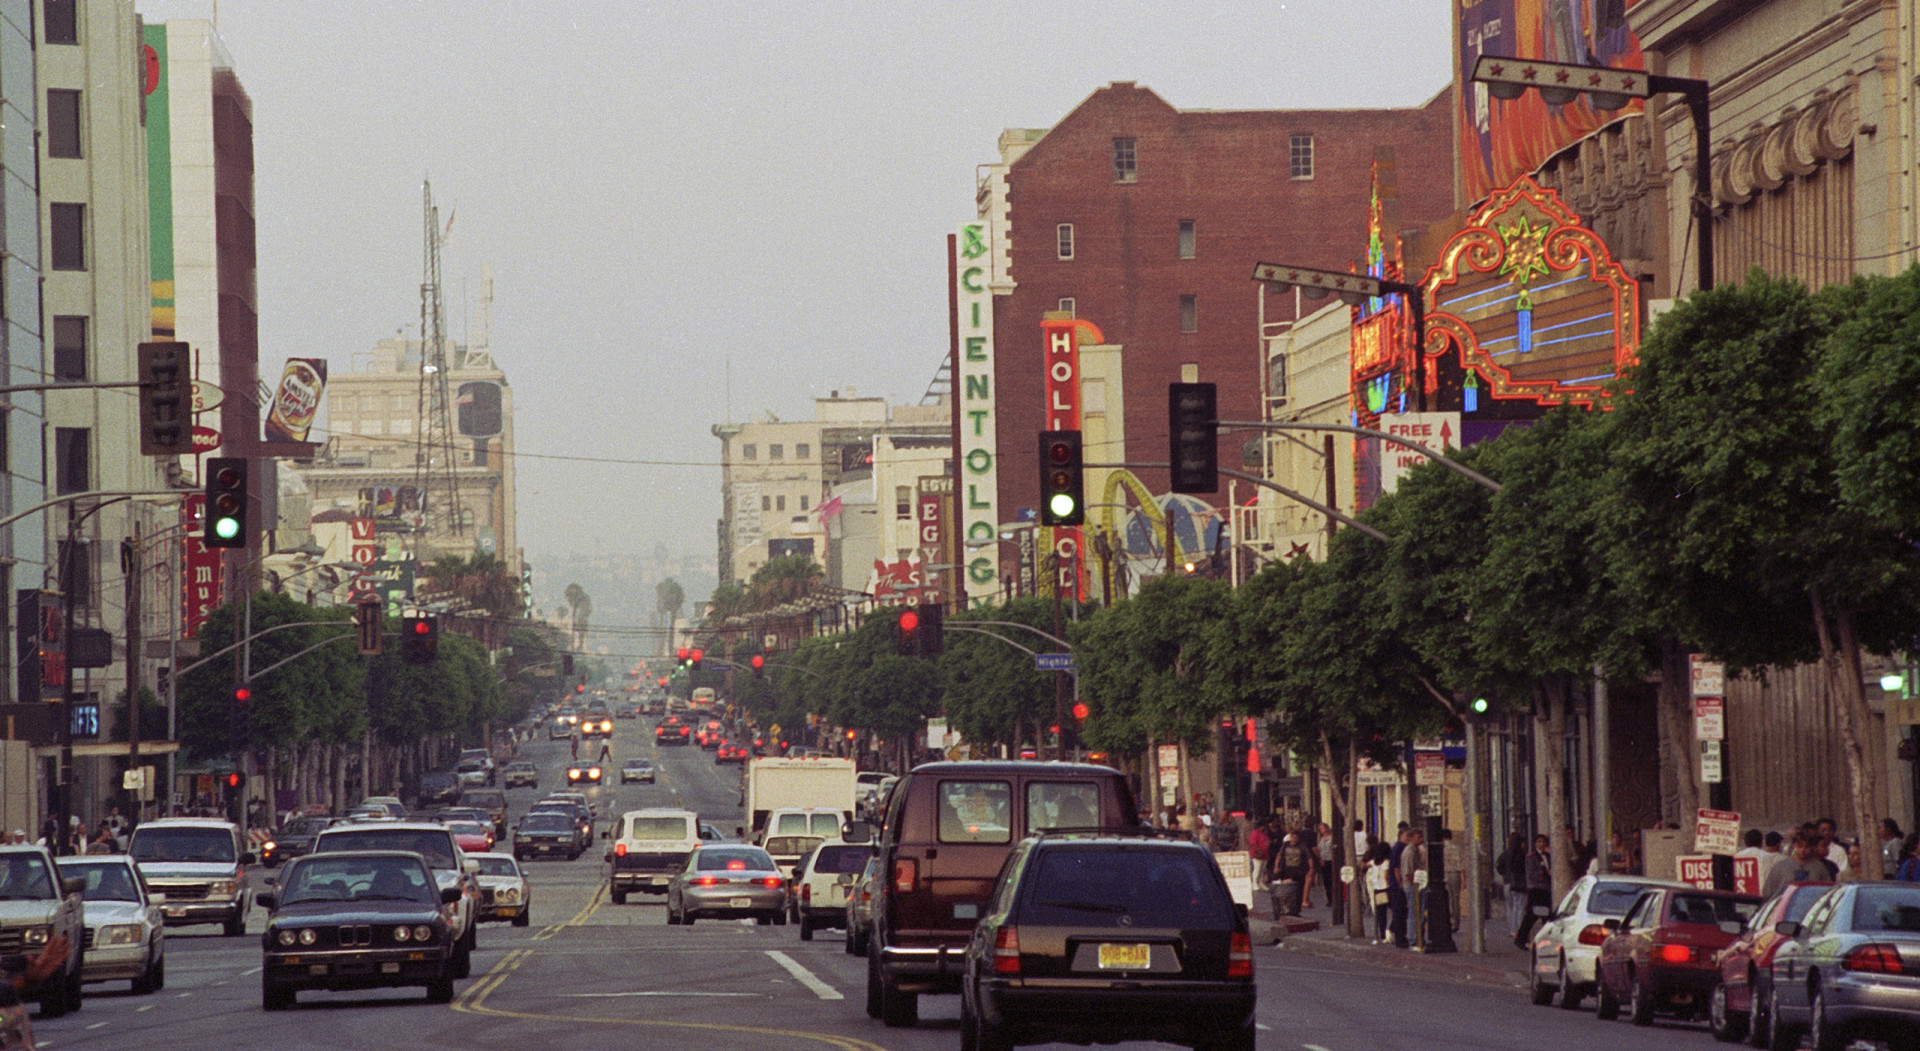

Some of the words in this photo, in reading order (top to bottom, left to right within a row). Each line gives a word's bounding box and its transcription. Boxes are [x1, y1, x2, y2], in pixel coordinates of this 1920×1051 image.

[1390, 424, 1432, 437] FREE
[1051, 332, 1077, 588] HOLOD
[1038, 658, 1074, 669] Highla
[1685, 861, 1754, 880] DISCNT
